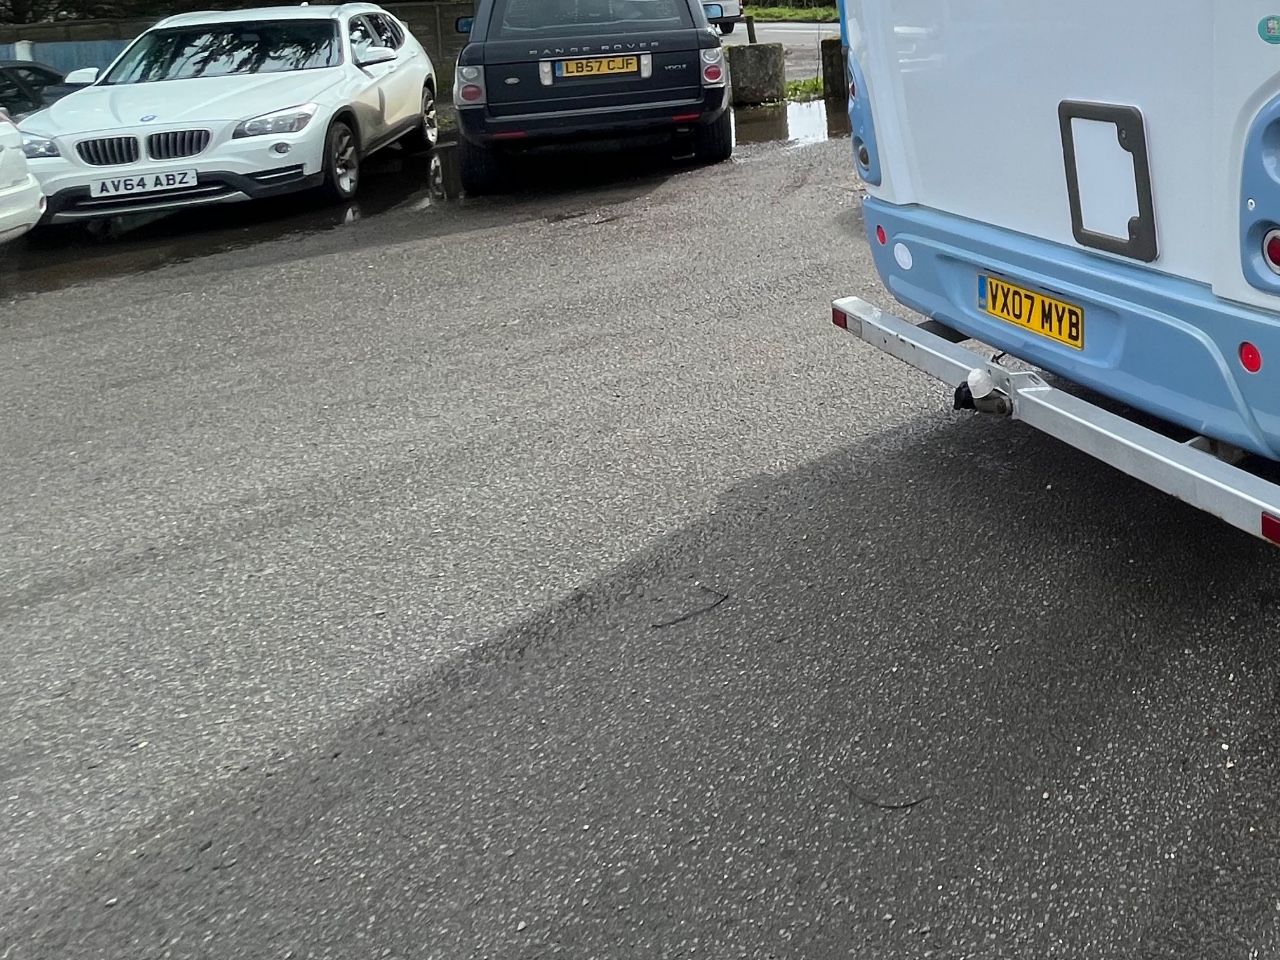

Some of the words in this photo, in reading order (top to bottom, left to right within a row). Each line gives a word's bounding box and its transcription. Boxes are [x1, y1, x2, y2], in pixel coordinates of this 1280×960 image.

[529, 46, 591, 55] RANGE
[601, 41, 659, 51] ROVER
[565, 60, 603, 74] LB57
[607, 58, 634, 71] CJF
[100, 177, 147, 194] AV64
[154, 172, 189, 188] ABZ
[989, 280, 1035, 324] VX07
[1041, 299, 1080, 342] MYB
